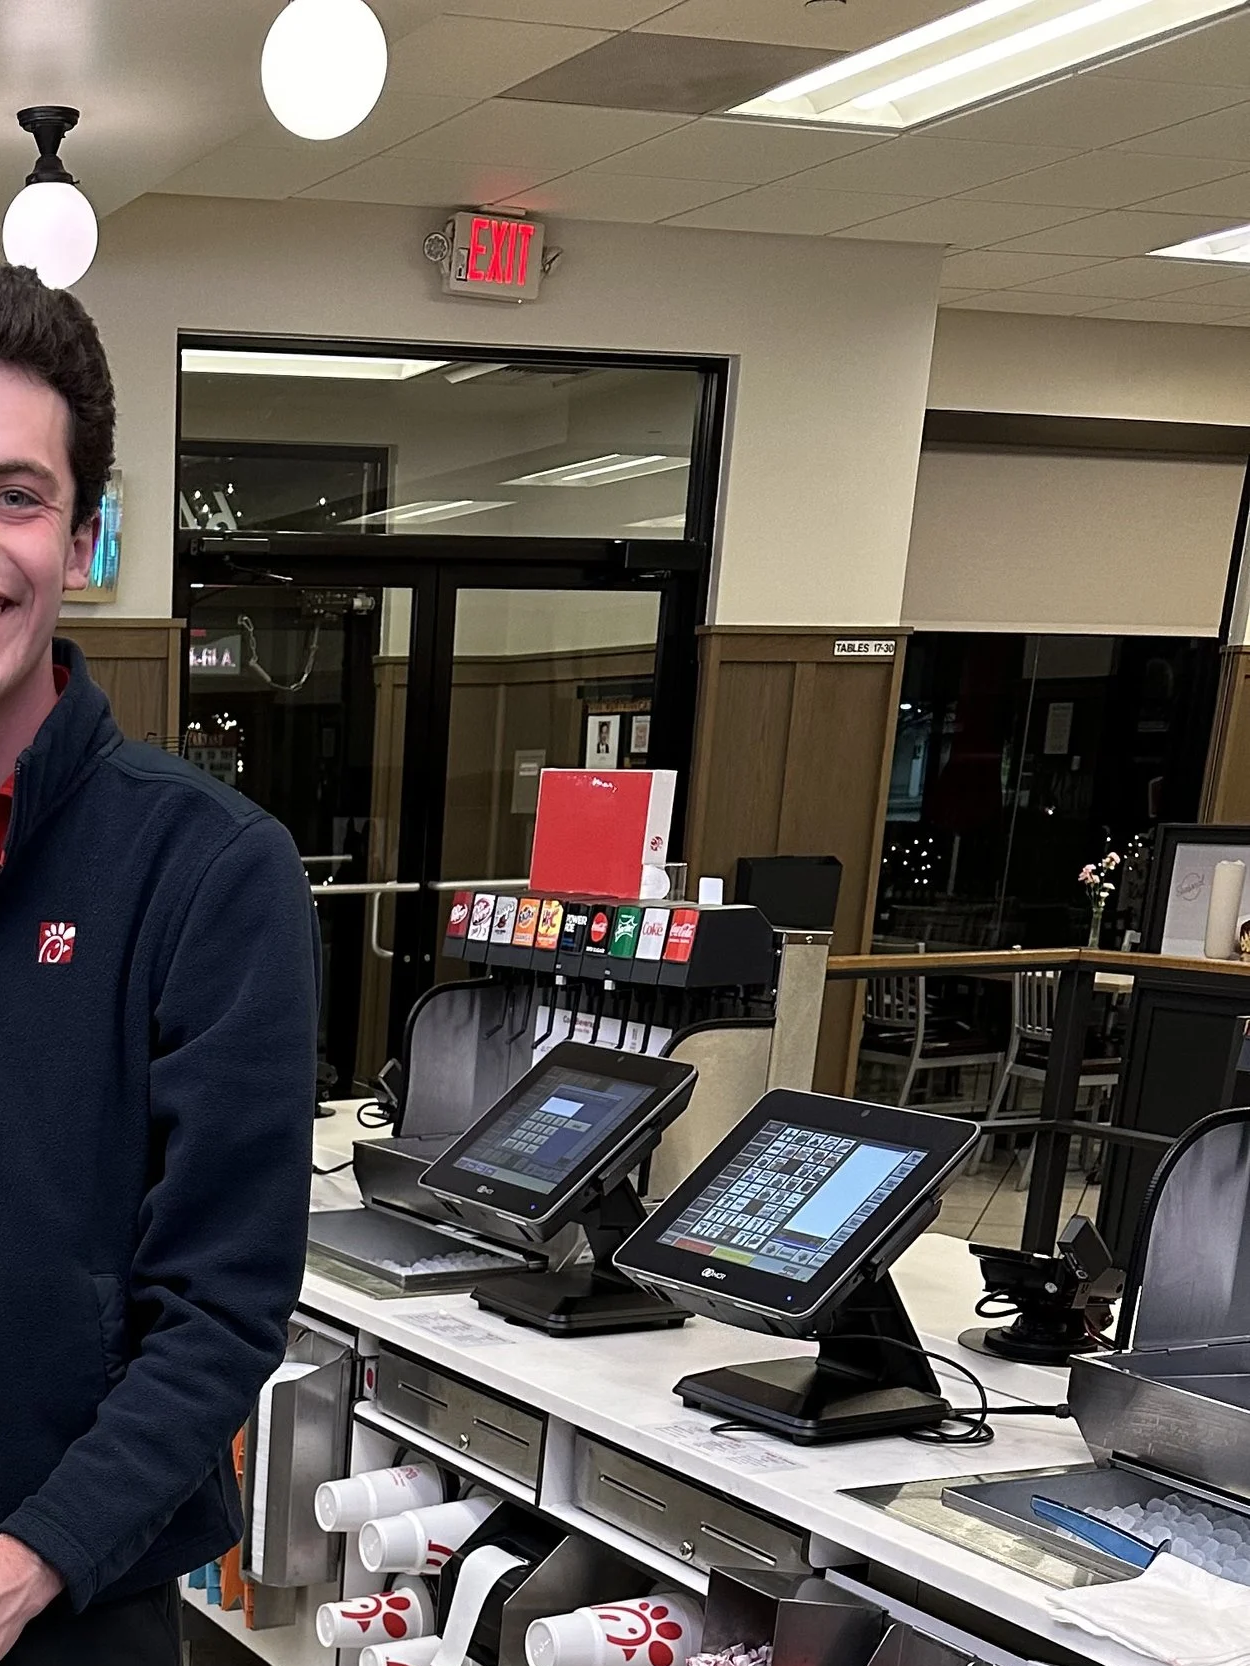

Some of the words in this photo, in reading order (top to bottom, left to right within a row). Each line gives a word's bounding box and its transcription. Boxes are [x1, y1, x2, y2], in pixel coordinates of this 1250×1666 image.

[467, 217, 535, 286] EXIT
[836, 643, 870, 653] TABLES
[874, 643, 894, 653] 17-30
[566, 914, 588, 926] POWER
[643, 921, 664, 937] Coke
